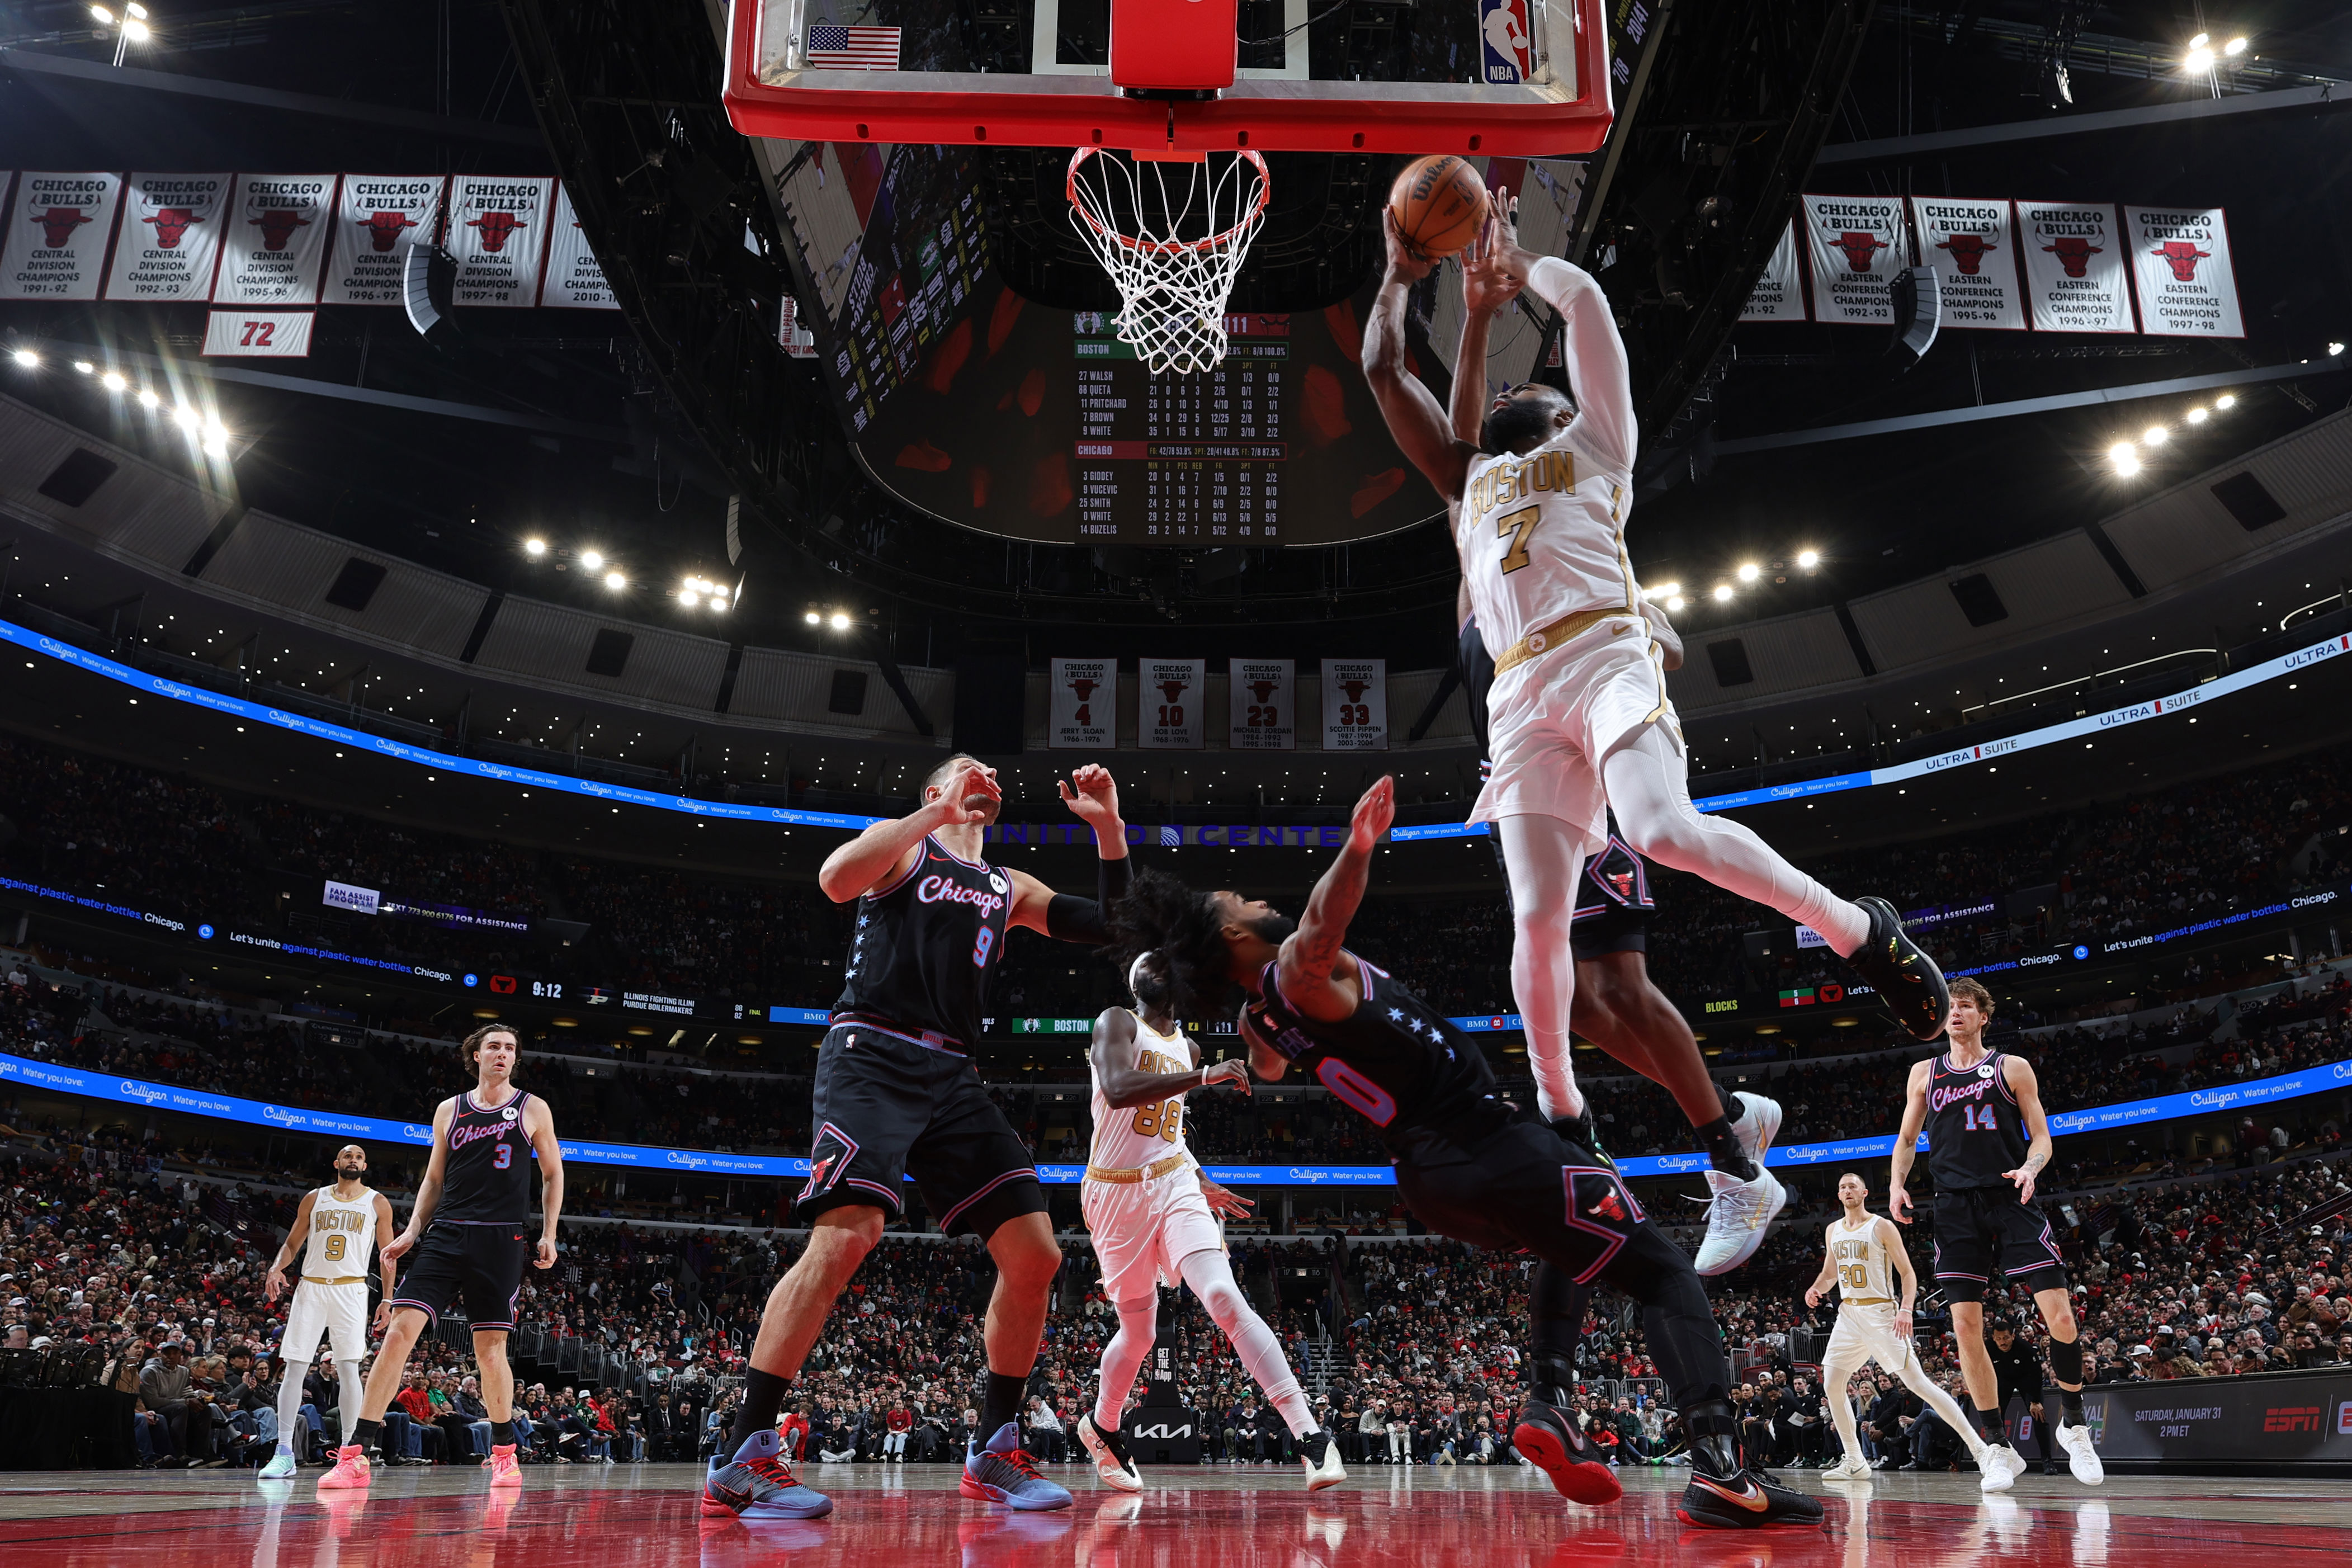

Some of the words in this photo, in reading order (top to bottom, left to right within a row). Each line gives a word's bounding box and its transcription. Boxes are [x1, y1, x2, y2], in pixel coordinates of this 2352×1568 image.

[1490, 66, 1513, 81] NBA
[1412, 156, 1456, 201] Wilson
[32, 180, 106, 192] CHICAGO
[143, 180, 217, 192] CHICAGO
[248, 182, 322, 193] CHICAGO
[465, 184, 537, 196] CHICAGO
[40, 195, 94, 205] BULLS
[152, 195, 205, 205] BULLS
[257, 197, 310, 207] BULLS
[475, 197, 526, 209] BULLS
[1926, 206, 1997, 219] CHICAGO
[2031, 210, 2103, 223] CHICAGO
[2140, 213, 2211, 226] CHICAGO
[1940, 220, 1990, 232] BULLS
[2044, 224, 2095, 235] BULLS
[2152, 228, 2203, 239] BULLS
[31, 250, 75, 258] CENTRAL
[143, 251, 186, 259] CENTRAL
[252, 252, 295, 260] CENTRAL
[469, 255, 512, 264] CENTRAL
[27, 262, 74, 270] DIVISION
[139, 262, 186, 270] DIVISION
[465, 268, 512, 276] DIVISION
[17, 273, 80, 281] CHAMPIONS
[129, 272, 191, 282] CHAMPIONS
[237, 276, 298, 284] CHAMPIONS
[1949, 276, 1991, 285] EASTERN
[456, 280, 518, 289] CHAMPIONS
[2057, 281, 2099, 289] EASTERN
[2166, 285, 2207, 294] EASTERN
[1941, 287, 2003, 297] CONFERENCE
[2049, 292, 2112, 302] CONFERENCE
[1943, 299, 2004, 309] CHAMPIONS
[2158, 296, 2219, 306] CONFERENCE
[2052, 304, 2112, 314] CHAMPIONS
[2159, 308, 2220, 318] CHAMPIONS
[240, 322, 276, 346] 72
[782, 328, 792, 343] WILL
[1078, 344, 1109, 355] BOSTON
[1079, 371, 1087, 380] 27
[1090, 371, 1113, 381] WALSH
[1079, 385, 1087, 394] 88
[1090, 385, 1111, 395] QUETA
[1081, 399, 1087, 408] 11
[1090, 399, 1126, 408] PRITCHARD
[1083, 413, 1087, 422] 7
[1090, 413, 1113, 422] BROWN
[1083, 427, 1087, 436] 9
[1090, 426, 1111, 436] WHITE
[1078, 445, 1112, 455] CHICAGO
[1083, 471, 1087, 480] 3
[1090, 471, 1113, 481] GIDDEY
[1083, 485, 1087, 494] 9
[1090, 485, 1117, 494] VUCEVIC
[1470, 451, 1576, 529] BOSTON
[1079, 498, 1087, 507] 25
[1090, 498, 1110, 507] SMITH
[1083, 512, 1088, 521] 0
[1090, 512, 1111, 521] WHITE
[1080, 525, 1087, 533] 14
[1090, 525, 1117, 534] BUZELIS
[1498, 504, 1539, 575] 7
[2100, 706, 2151, 726] ULTRA
[2166, 691, 2202, 710] SUITE
[1075, 704, 1090, 726] 4
[1158, 705, 1183, 726] 10
[1248, 706, 1277, 727] 23
[1340, 705, 1369, 726] 33
[1925, 751, 1971, 770] ULTRA
[1984, 739, 2018, 755] SUITE
[984, 824, 1146, 845] NITD
[1199, 825, 1354, 847] CENTE
[330, 887, 346, 896] FAN
[348, 891, 374, 901] ASSIST
[917, 875, 1004, 919] Chicago
[329, 894, 373, 908] PROGRAM
[386, 901, 406, 912] TEXT
[408, 906, 421, 915] 773
[436, 912, 454, 920] 6176
[456, 914, 473, 923] FOR
[476, 918, 527, 931] ASSISTANCE
[972, 925, 994, 968] 9
[255, 938, 281, 949] unite
[282, 942, 318, 956] against
[319, 949, 350, 962] plastic
[352, 956, 377, 967] water
[414, 967, 452, 982] Chicago.
[532, 981, 562, 999] 9:12
[624, 992, 649, 1002] ILLINOIS
[650, 995, 677, 1005] FIGHTING
[623, 1000, 648, 1009] PURDUE
[649, 1003, 693, 1015] BOILERMAKERS
[1706, 999, 1737, 1013] BLOCKS
[1054, 1020, 1089, 1031] BOSTON
[1215, 1021, 1231, 1033] 111
[1467, 1019, 1489, 1028] BMO
[923, 1033, 942, 1045] BULLS
[121, 1081, 167, 1103] Culligan
[173, 1095, 197, 1106] Water
[197, 1101, 212, 1109] you
[1931, 1079, 1995, 1112] Chicago
[2190, 1092, 2239, 1107] Culligan
[2244, 1088, 2269, 1098] Water
[2270, 1085, 2285, 1095] you
[1132, 1099, 1180, 1144] 88
[1964, 1104, 1997, 1131] 14
[451, 1119, 518, 1151] Chicago
[493, 1144, 512, 1169] 3
[315, 1209, 366, 1234] BOSTON
[325, 1234, 346, 1261] 9
[1833, 1240, 1869, 1262] BOSTON
[1839, 1264, 1868, 1288] 30
[1158, 1348, 1169, 1358] GET
[1158, 1359, 1169, 1369] THE
[1160, 1370, 1172, 1382] App
[2135, 1409, 2174, 1422] SATURDAY,
[2175, 1408, 2212, 1420] JANUARY
[2212, 1407, 2221, 1419] 31
[2264, 1406, 2321, 1432] ESPN
[1135, 1424, 1191, 1438] KIA
[2160, 1426, 2166, 1437] 2
[2166, 1426, 2179, 1437] PM
[2180, 1425, 2189, 1437] ET
